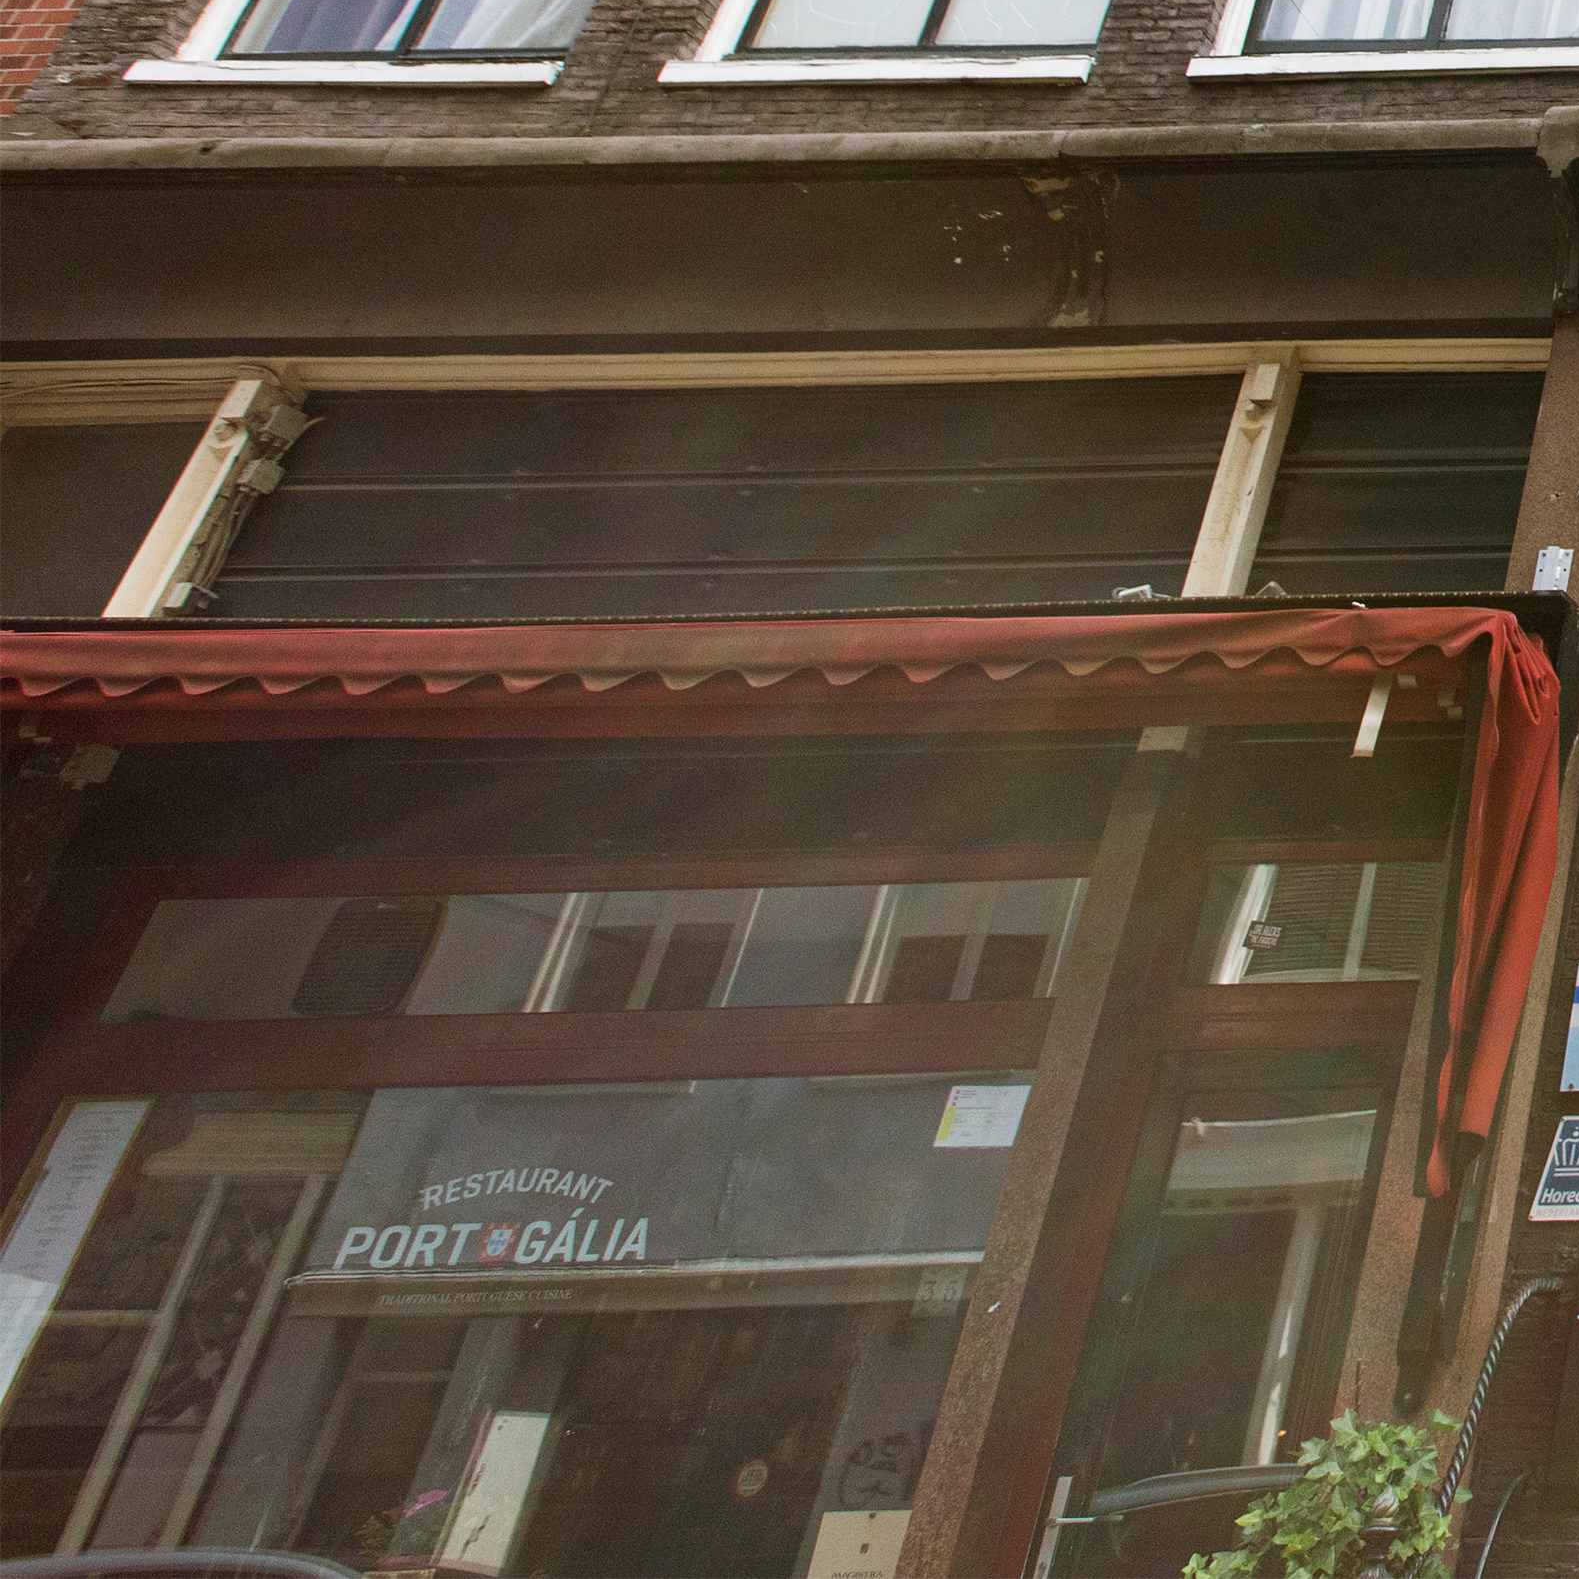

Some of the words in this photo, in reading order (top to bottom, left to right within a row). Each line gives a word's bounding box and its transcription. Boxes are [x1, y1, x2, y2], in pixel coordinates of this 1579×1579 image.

[420, 1167, 614, 1211] RESTAURANT
[379, 1293, 449, 1306] TRADITIONAL
[453, 1290, 528, 1304] PORTUGUESE
[528, 1288, 574, 1300] CUISINE
